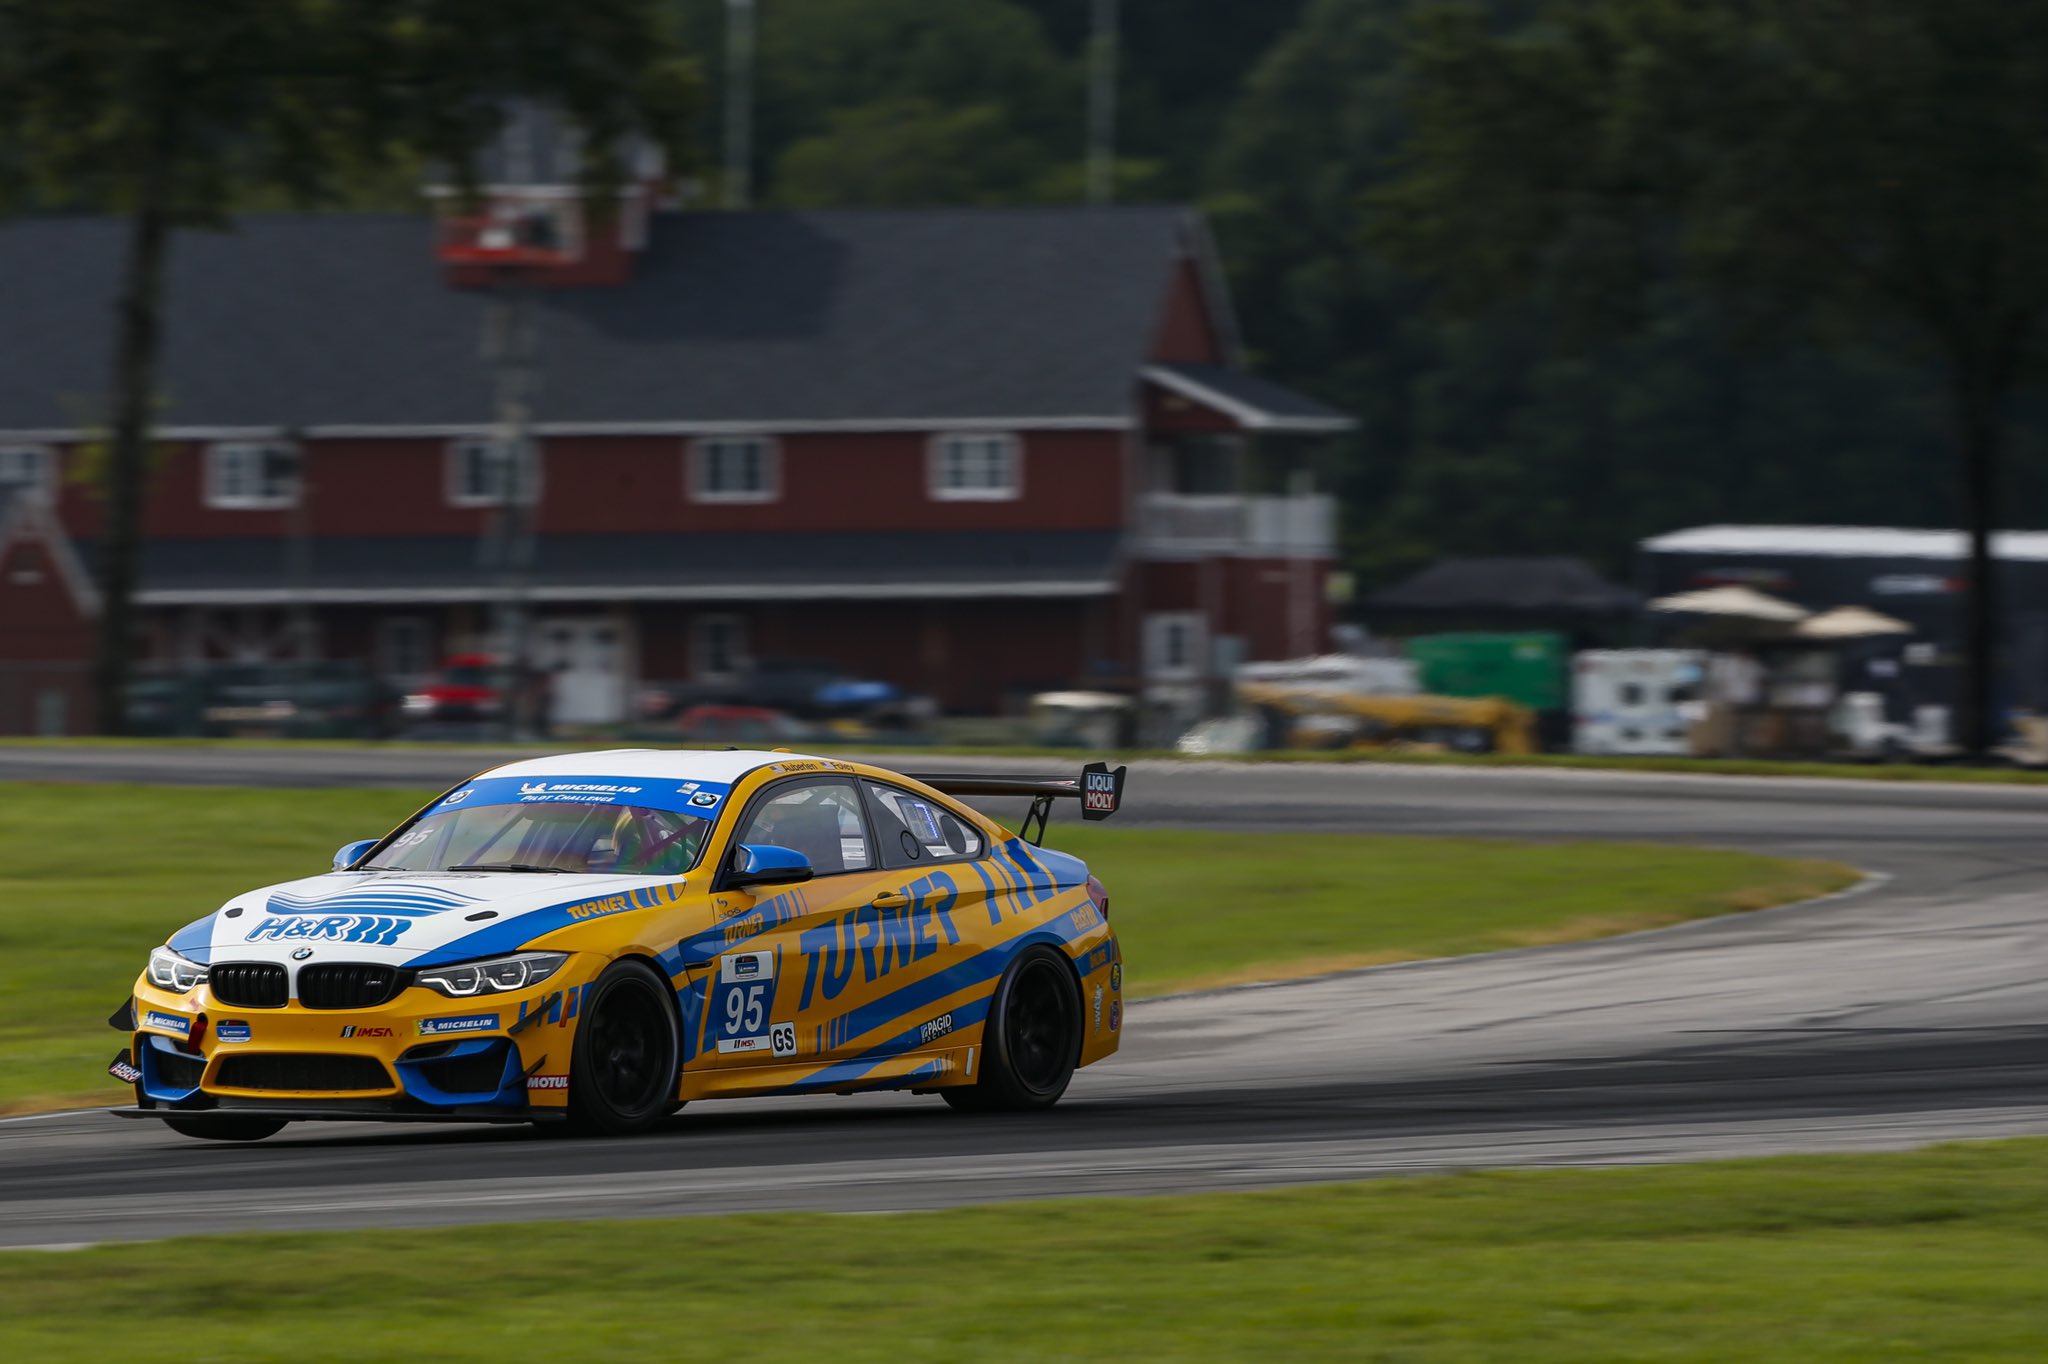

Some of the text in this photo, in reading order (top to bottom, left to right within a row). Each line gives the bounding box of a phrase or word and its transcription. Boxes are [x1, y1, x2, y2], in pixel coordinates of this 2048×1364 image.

[548, 783, 643, 793] MICHELIN
[1087, 774, 1113, 791] LIQUI
[520, 794, 616, 802] PILOT CHALLENGE
[1087, 792, 1114, 808] MOLY
[393, 828, 434, 849] 95
[566, 895, 630, 919] TURNER
[244, 915, 350, 943] H&R
[723, 912, 763, 946] TURNER
[799, 870, 960, 1010] TURNER
[725, 985, 764, 1034] 95
[154, 1016, 187, 1029] MICHELIN
[436, 1018, 493, 1030] MICHELIN
[927, 1013, 952, 1036] PAGID
[356, 1027, 394, 1037] IMSA
[772, 1027, 795, 1052] GS
[110, 1067, 136, 1083] MOLY
[116, 1061, 143, 1078] LIQUI
[526, 1076, 569, 1088] MOTUL
